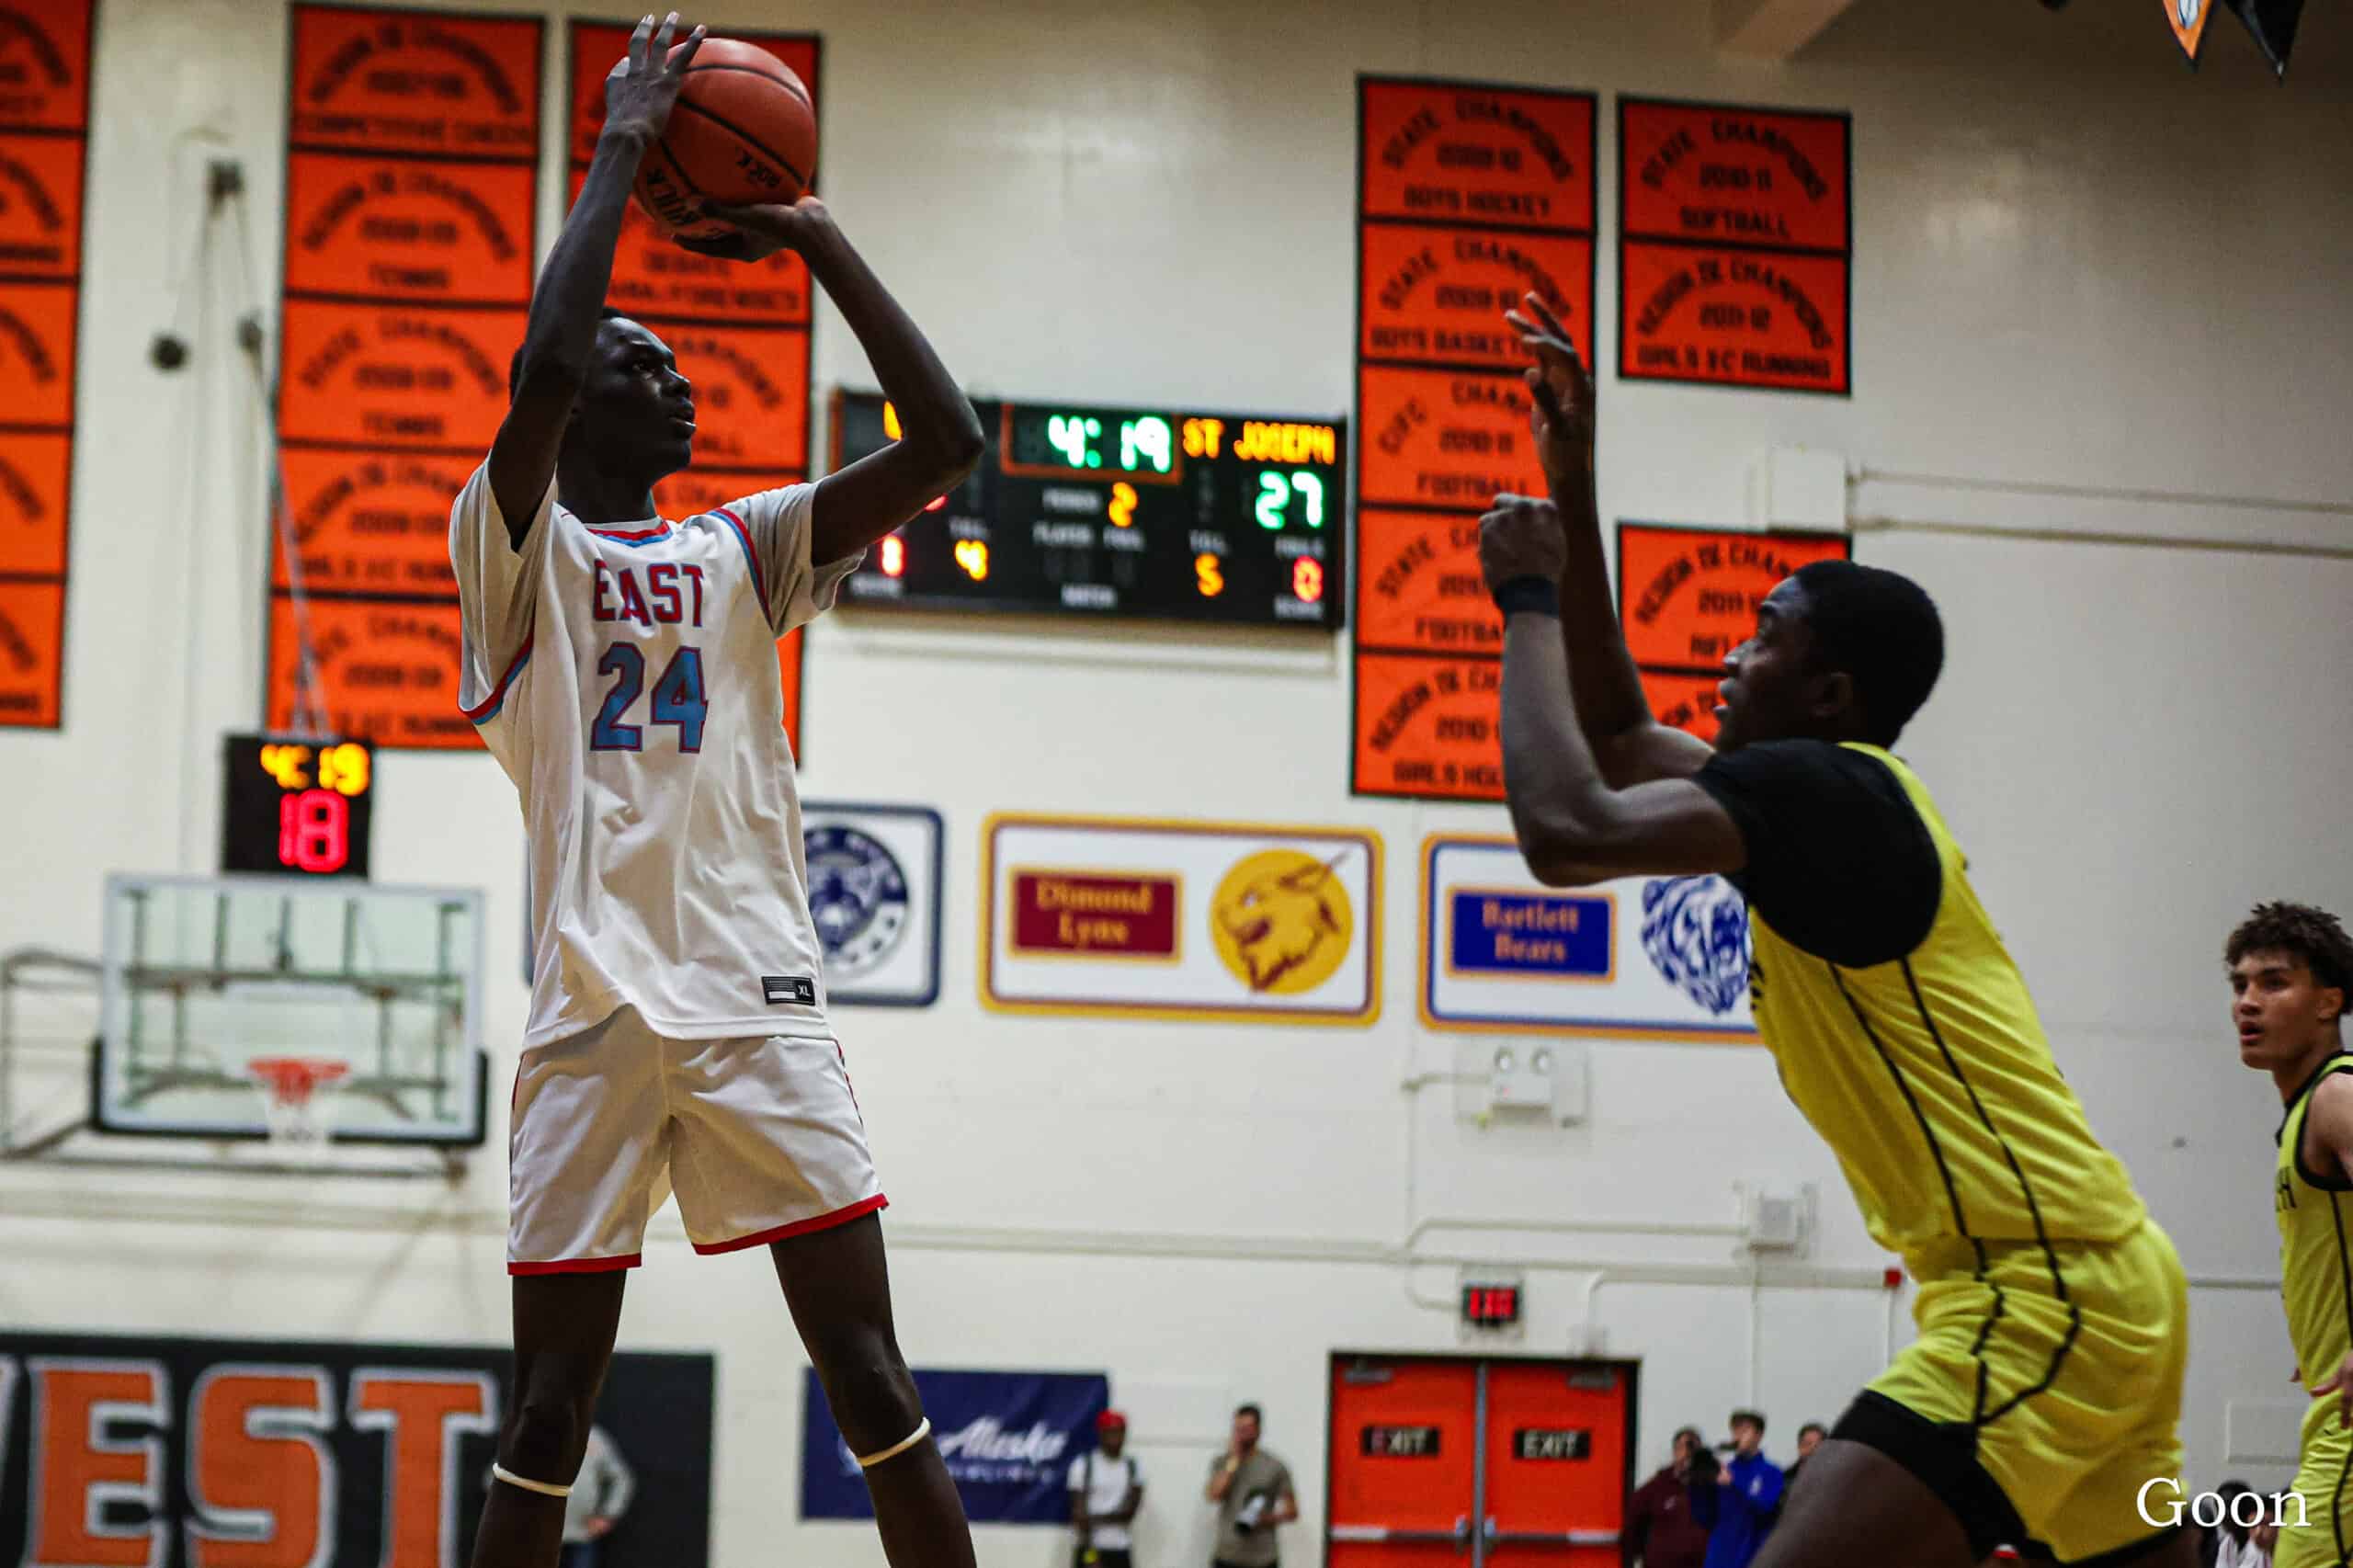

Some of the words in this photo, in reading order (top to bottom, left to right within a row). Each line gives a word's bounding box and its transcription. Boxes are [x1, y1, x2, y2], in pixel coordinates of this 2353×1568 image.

[1455, 93, 1574, 181] CHAMPIONS
[1711, 118, 1828, 203] CHAMPIONS
[1048, 415, 1174, 472] 4:19
[1183, 418, 1224, 459] ST
[1233, 421, 1336, 465] JOSEPH
[1108, 482, 1138, 528] 2
[1255, 471, 1324, 530] 27
[593, 558, 704, 627] EAST
[1415, 618, 1501, 642] FOOTBA
[590, 642, 708, 754] 24
[278, 790, 349, 872] 18
[1037, 880, 1154, 914] Dimond
[1482, 901, 1579, 934] Bartlett
[1059, 912, 1130, 949] Lynx
[1494, 934, 1567, 962] Bears
[798, 984, 812, 997] XL
[0, 1355, 498, 1568] EST
[1369, 1428, 1427, 1455] EXIT
[1522, 1431, 1581, 1458] EXIT
